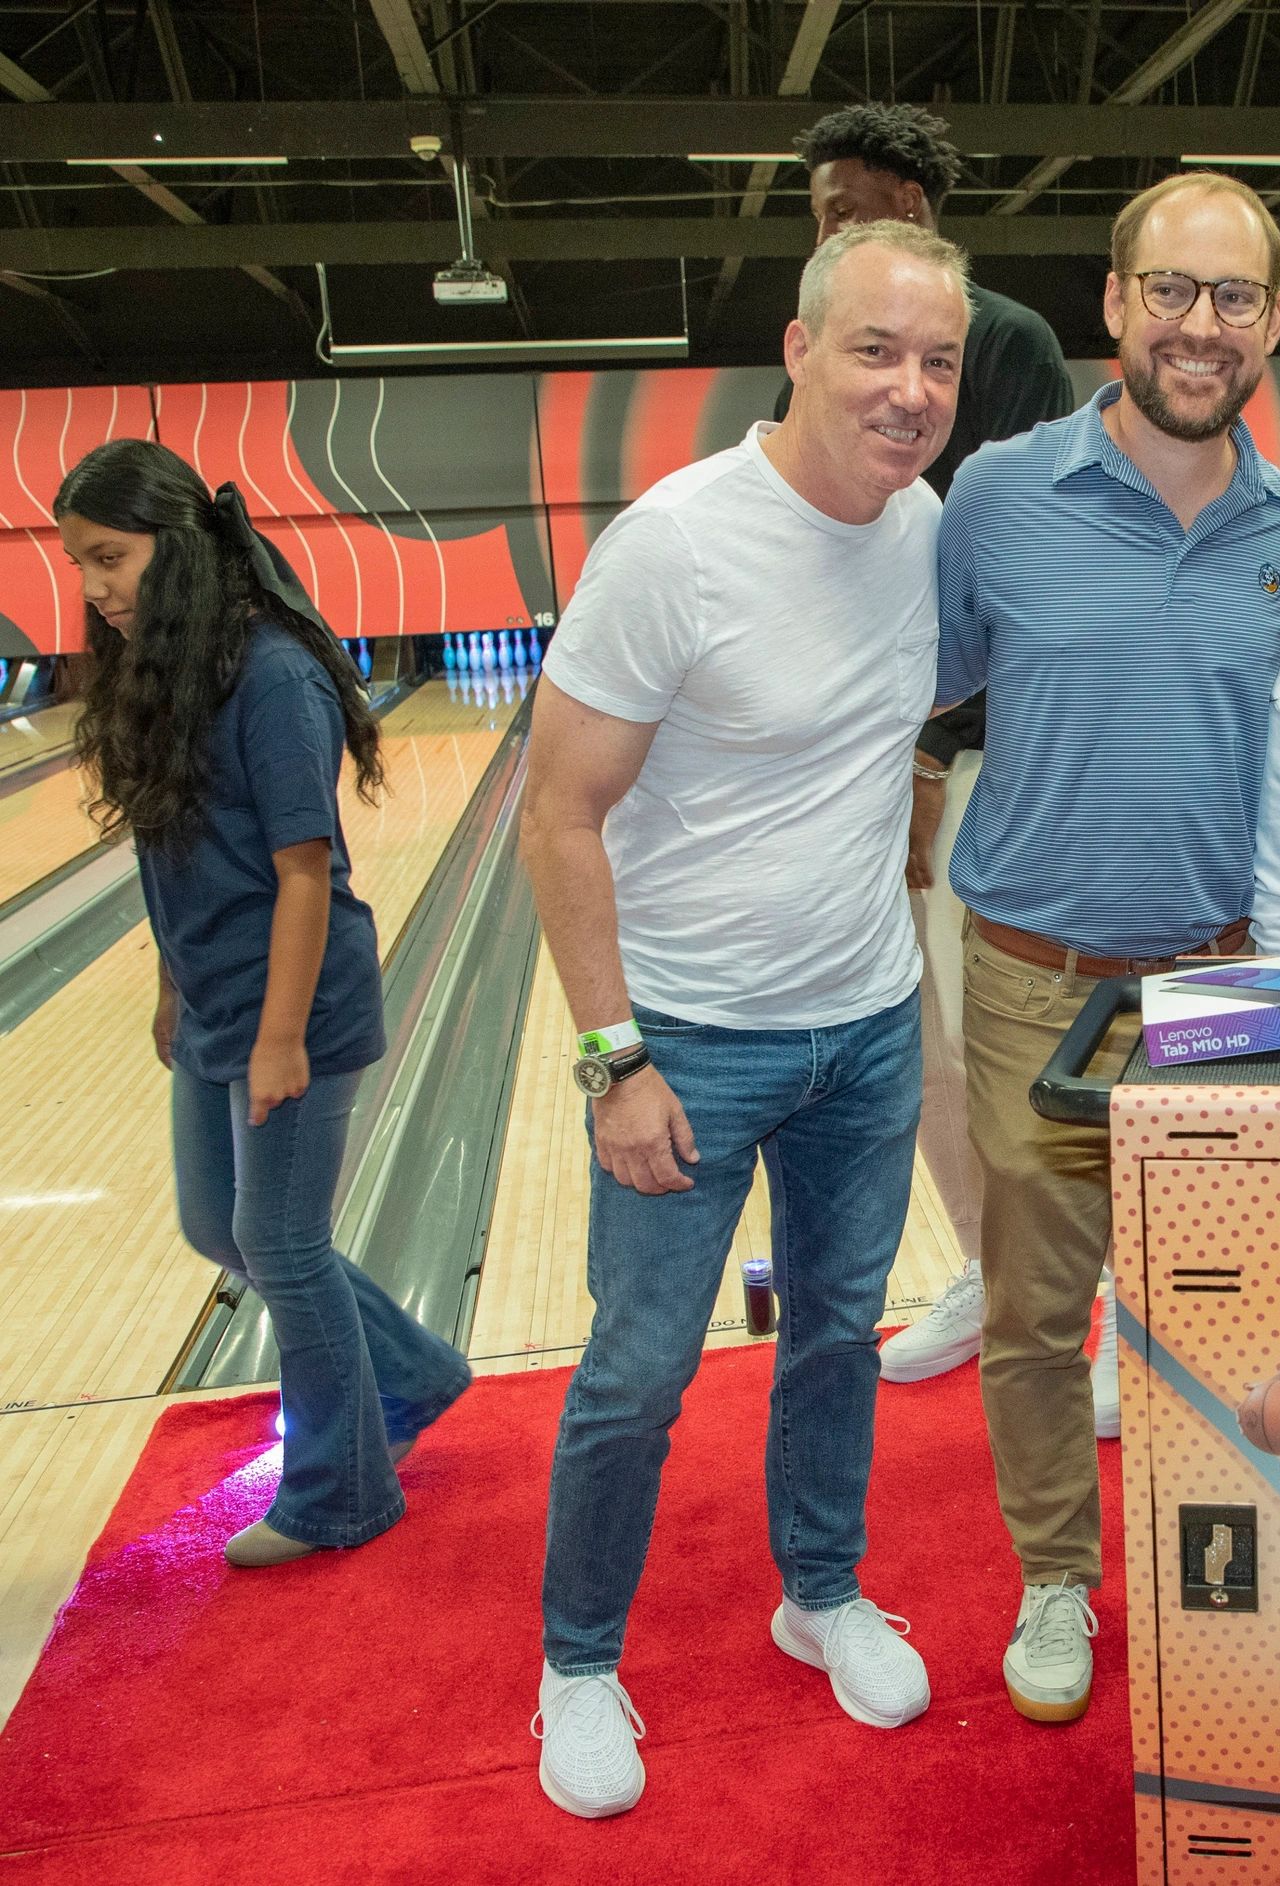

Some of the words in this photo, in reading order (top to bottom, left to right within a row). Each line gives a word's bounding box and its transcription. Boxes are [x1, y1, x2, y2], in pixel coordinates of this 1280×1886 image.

[534, 611, 555, 627] 16
[1159, 1026, 1212, 1043] Lenovo
[1160, 1043, 1189, 1058] Tab
[1192, 1038, 1222, 1053] M10
[1226, 1034, 1250, 1049] HD
[0, 1400, 36, 1410] INE
